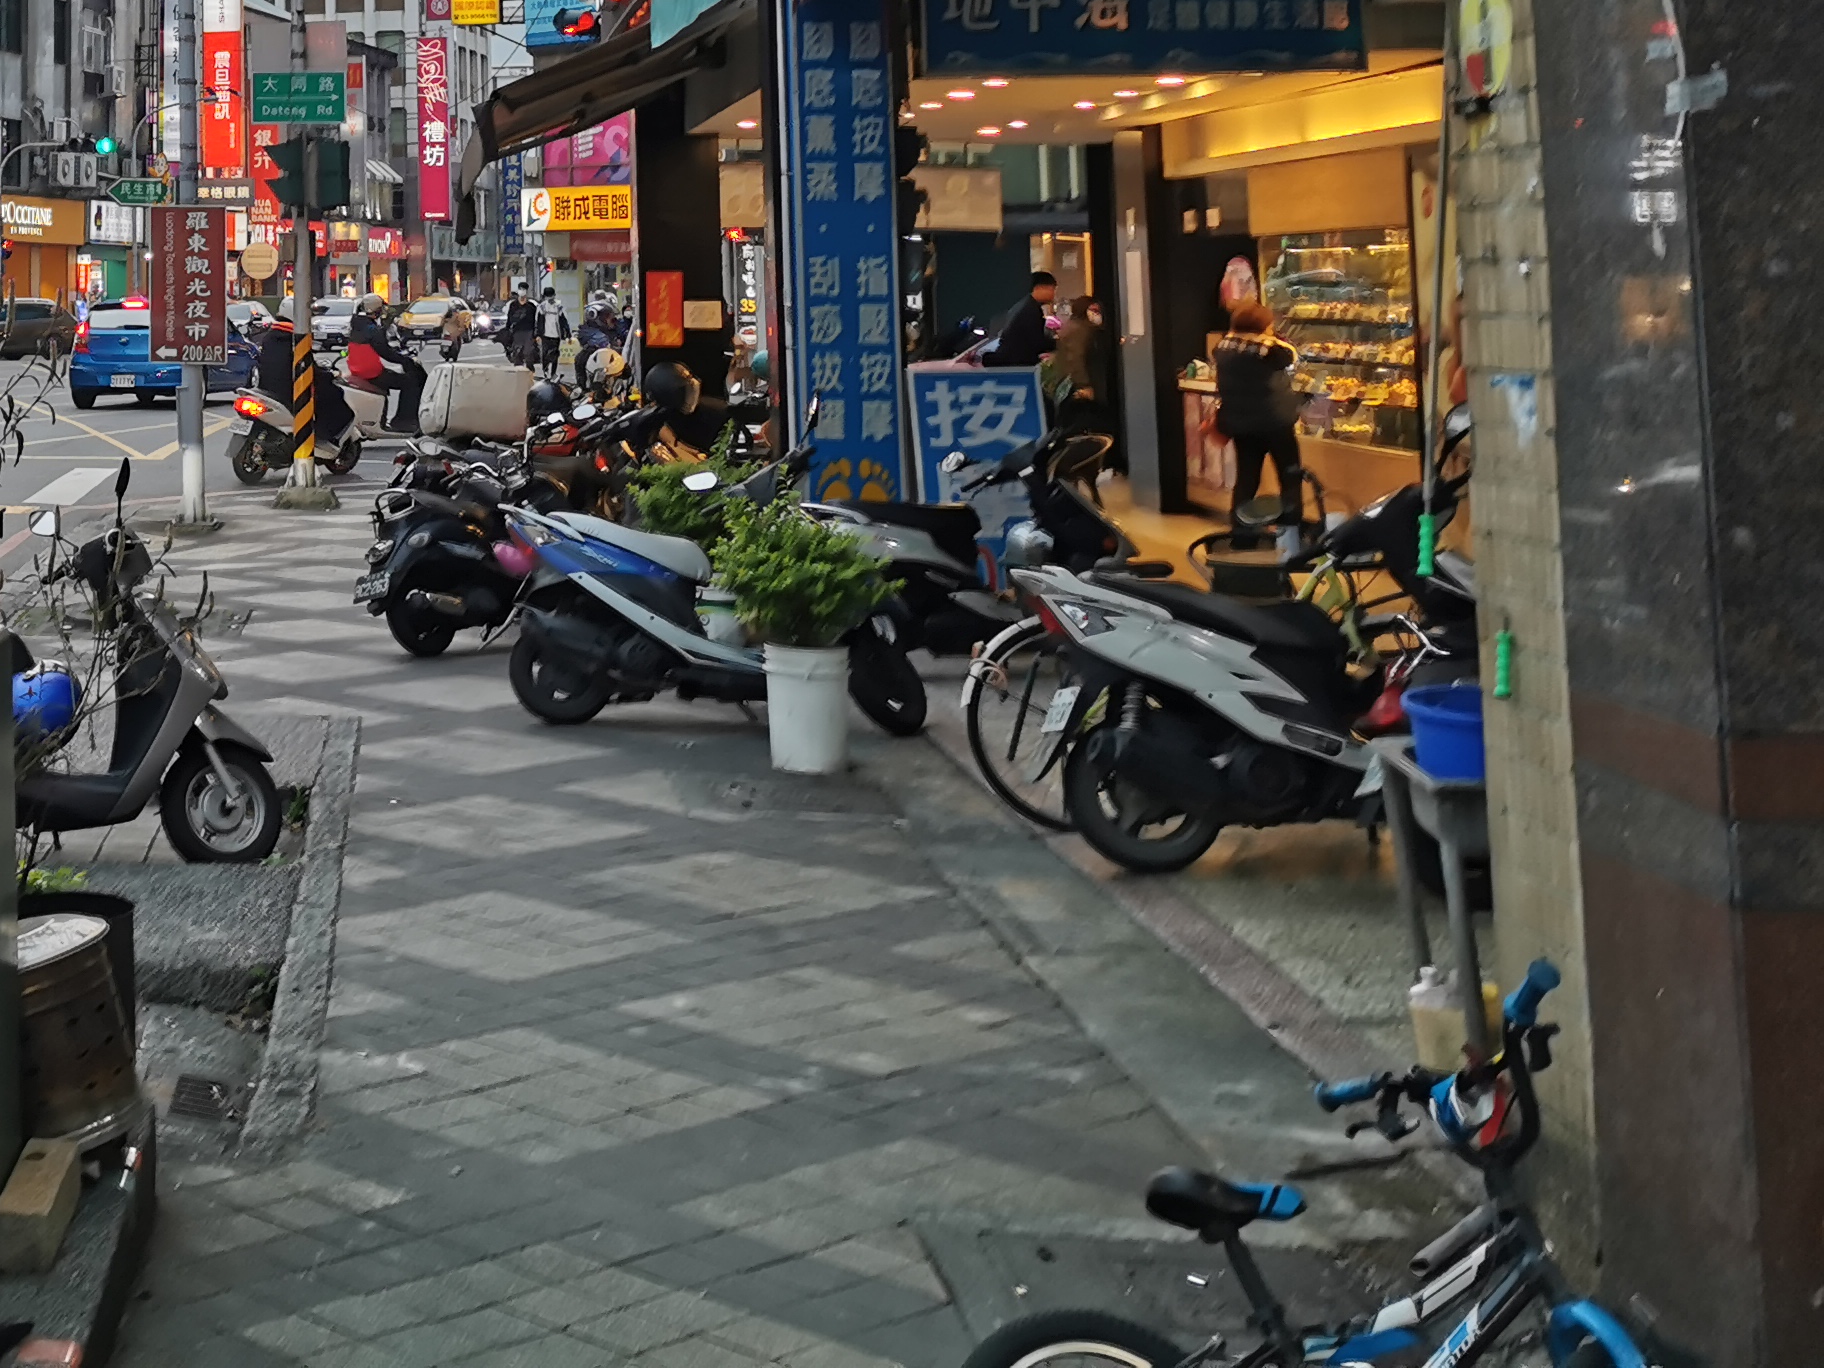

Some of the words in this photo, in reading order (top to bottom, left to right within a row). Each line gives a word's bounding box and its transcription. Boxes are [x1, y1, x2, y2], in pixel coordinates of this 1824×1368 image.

[262, 75, 335, 94] 大同路
[262, 104, 307, 119] Datong
[316, 104, 336, 116] Rd.
[253, 129, 273, 170] 銀行
[422, 120, 446, 167] 禮坊
[2, 201, 53, 227] L'OCCITANE
[252, 207, 272, 215] NAN
[252, 214, 277, 223] BANK
[554, 194, 629, 221] 聯成電腦
[163, 211, 175, 252] Luodong
[184, 211, 211, 342] 羅東觀光夜市
[163, 285, 175, 310] Night
[182, 345, 223, 362] 200公尺
